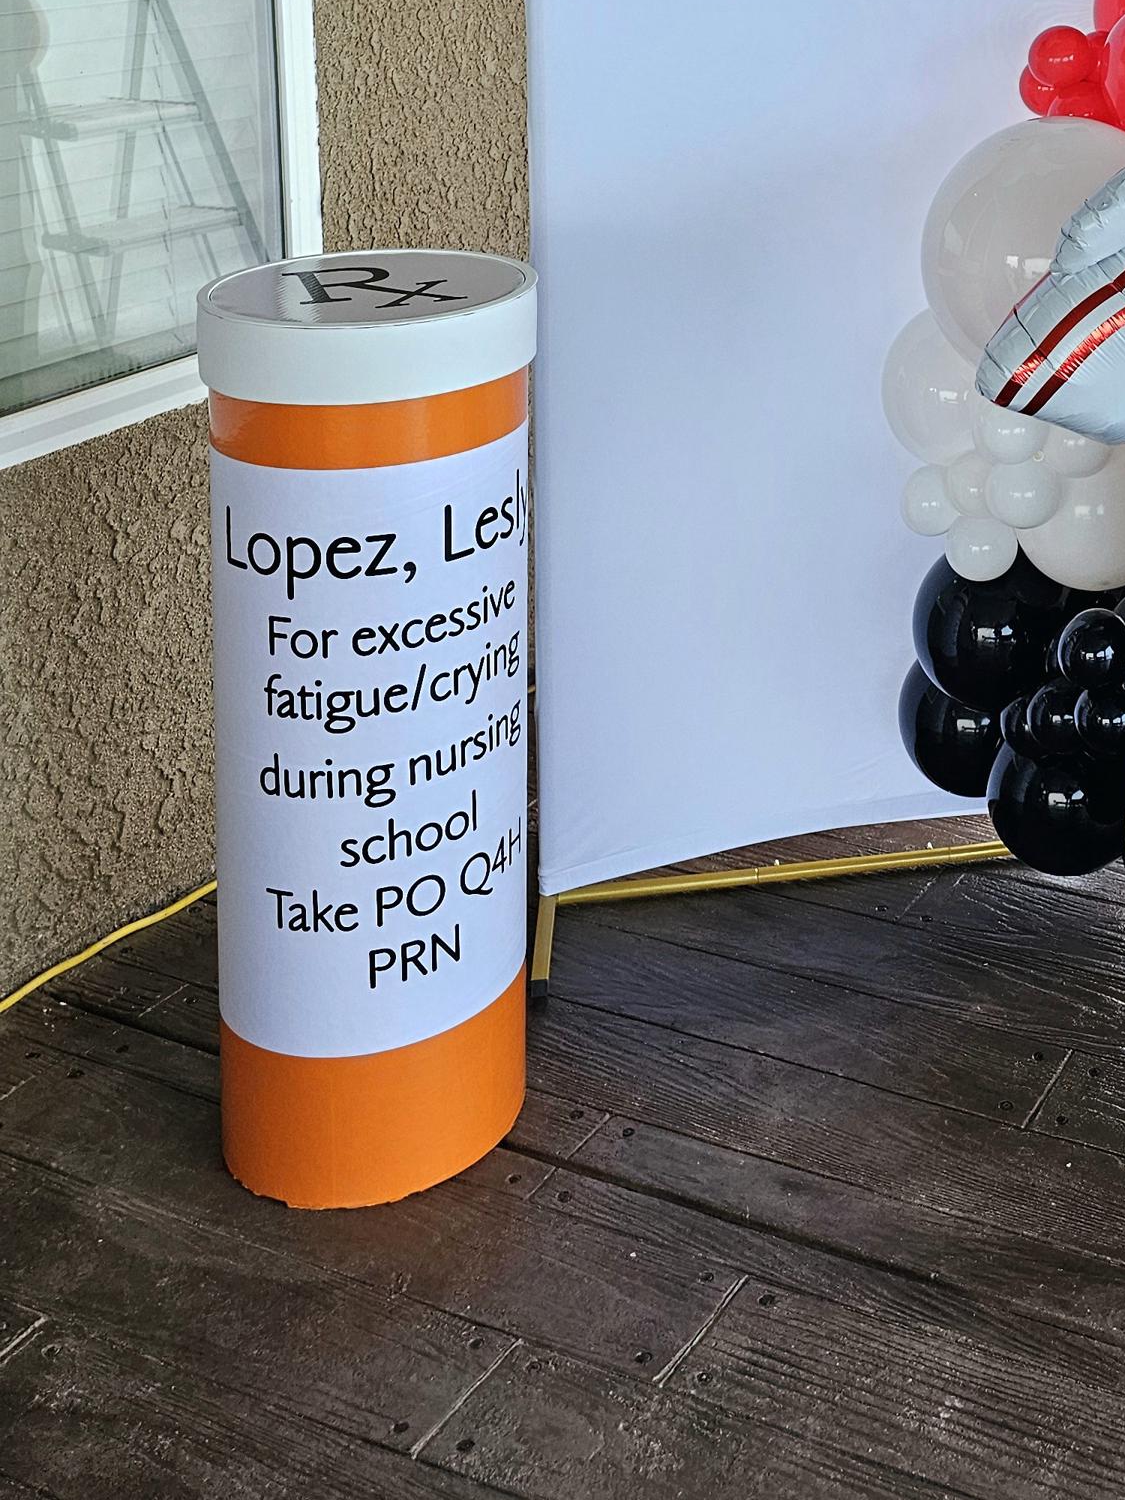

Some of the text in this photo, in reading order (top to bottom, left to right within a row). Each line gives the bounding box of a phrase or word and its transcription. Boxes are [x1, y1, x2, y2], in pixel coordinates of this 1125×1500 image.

[282, 266, 468, 309] Rx
[226, 468, 528, 600] Lopez, Lesly
[268, 580, 516, 660] For excessive
[264, 630, 521, 734] fatigue/crying
[260, 699, 521, 808] during nursing
[266, 816, 522, 933] Take PO Q4H
[340, 790, 477, 868] school
[368, 924, 461, 989] PRN
